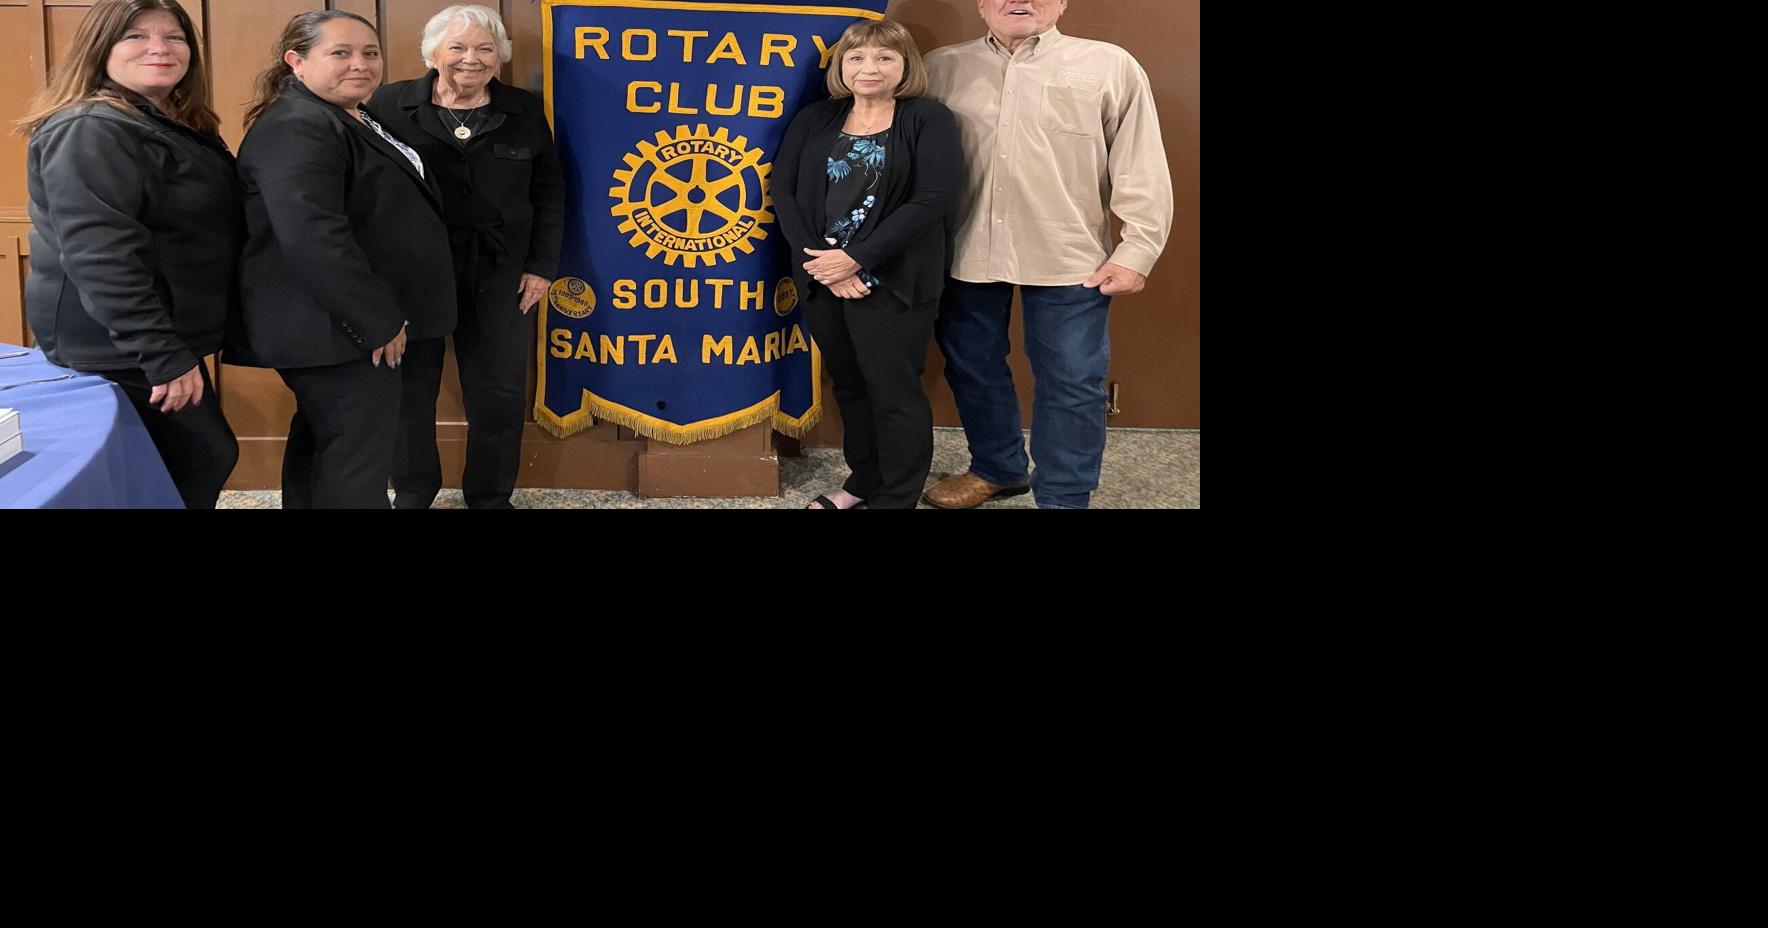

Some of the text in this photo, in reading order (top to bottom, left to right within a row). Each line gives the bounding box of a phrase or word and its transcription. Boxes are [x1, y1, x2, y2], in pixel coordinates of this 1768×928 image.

[575, 26, 839, 69] ROTARY
[626, 80, 785, 119] CLUB
[660, 140, 743, 163] ROTARY
[634, 210, 754, 251] INTERNATIONAL
[612, 278, 765, 311] SOUTH
[550, 323, 809, 366] SANTA MARIA
